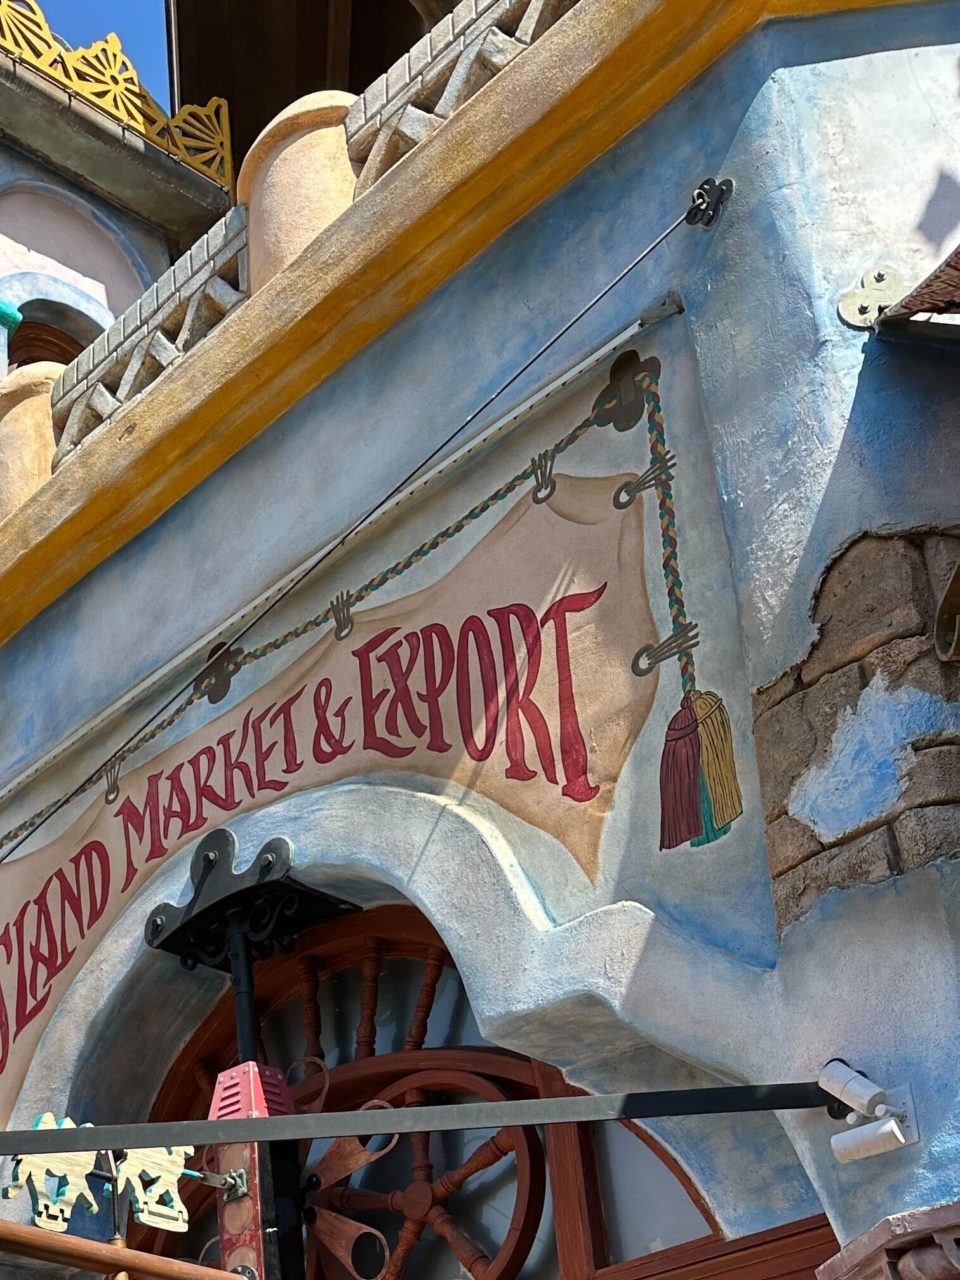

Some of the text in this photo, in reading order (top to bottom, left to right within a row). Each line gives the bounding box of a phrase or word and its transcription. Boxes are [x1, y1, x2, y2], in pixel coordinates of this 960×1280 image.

[114, 684, 307, 894] MARKET
[311, 676, 354, 765] &
[351, 582, 608, 803] EXPORT
